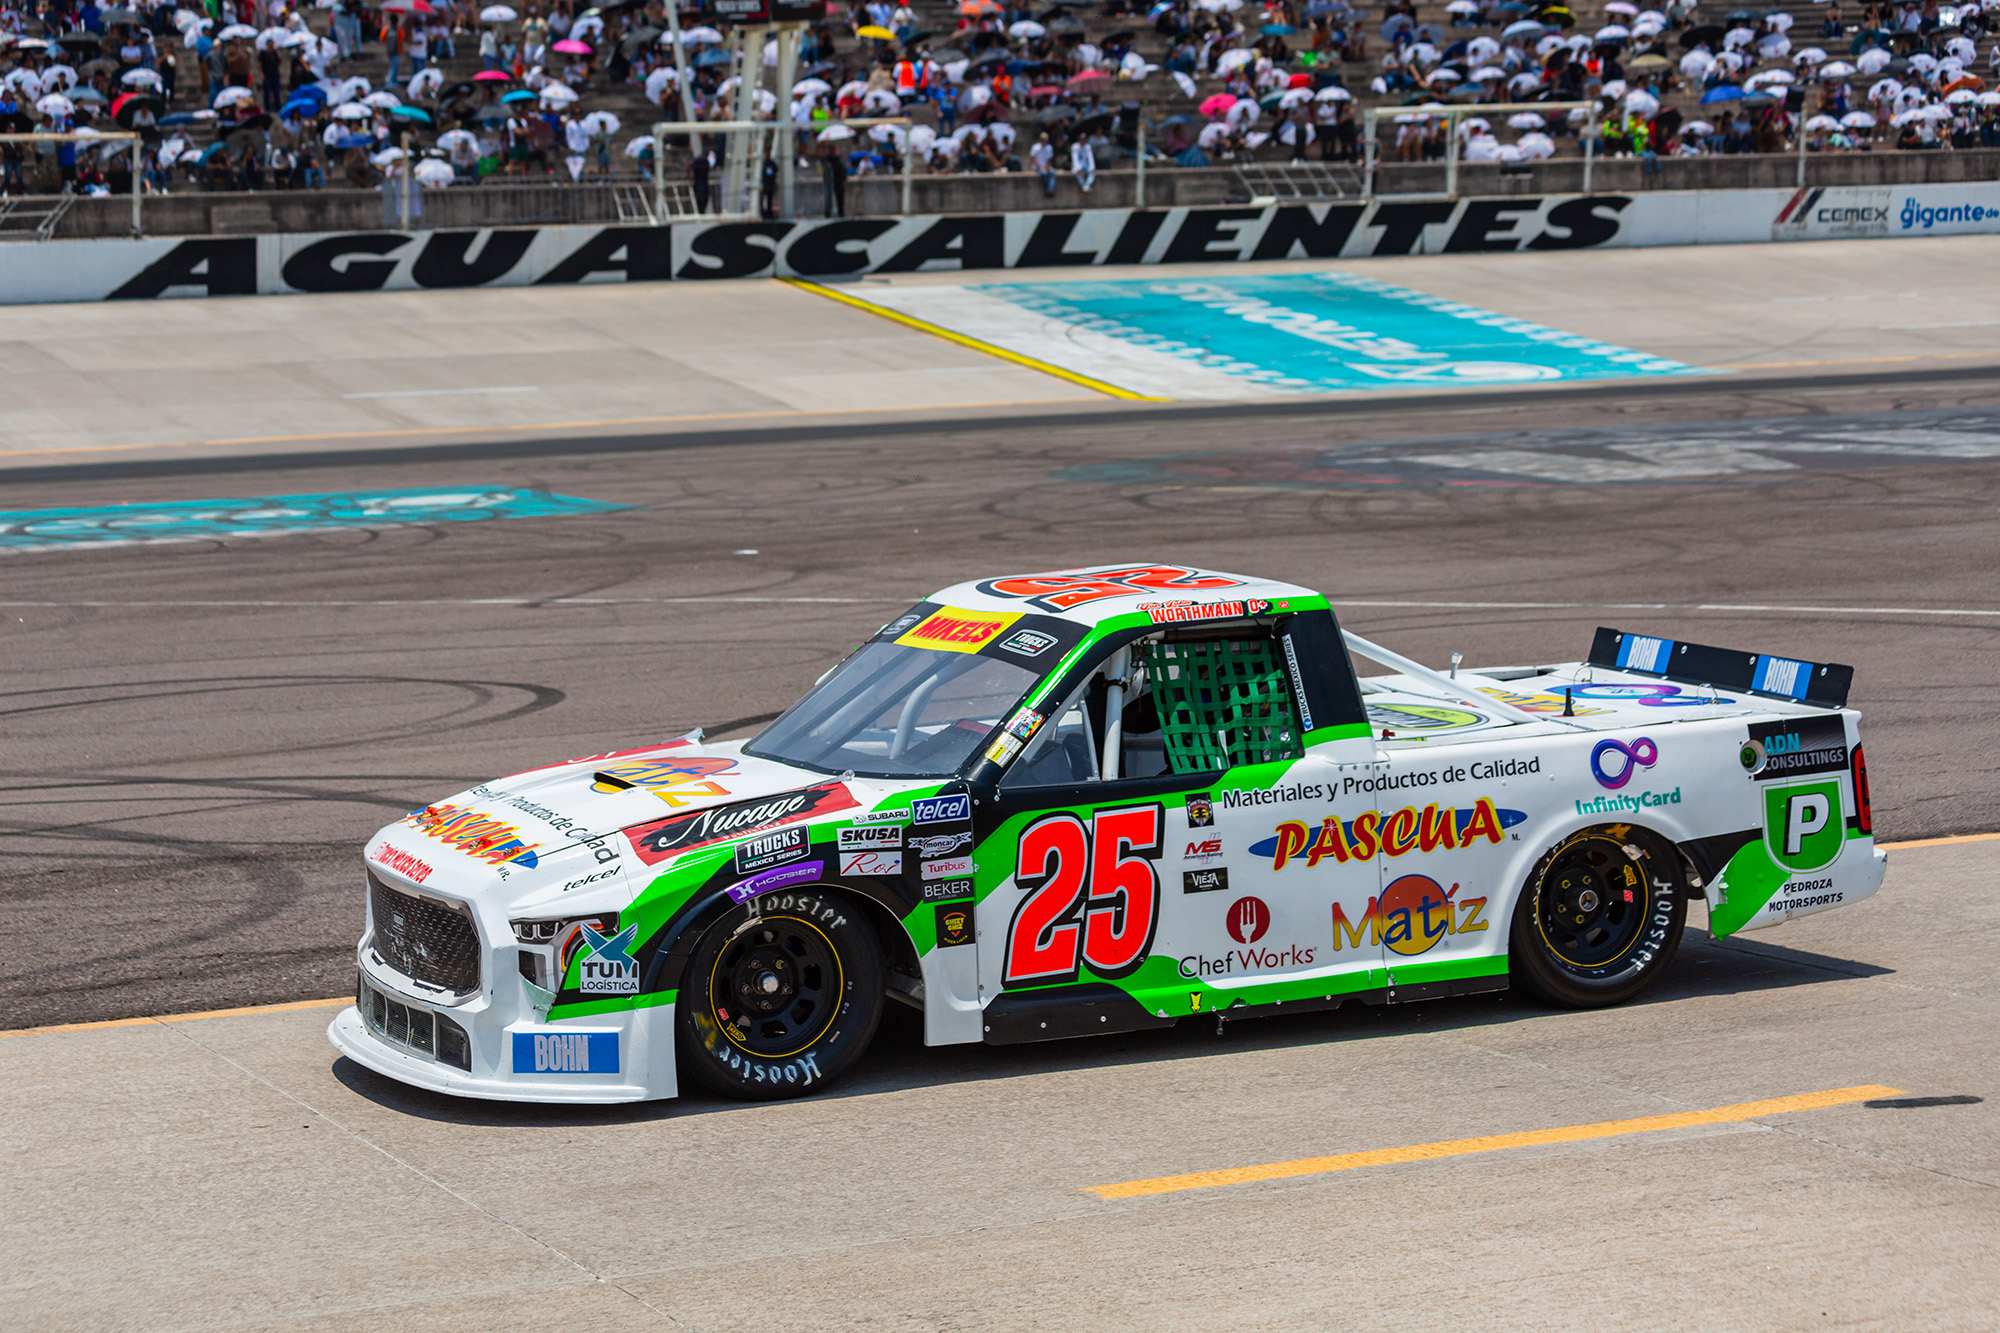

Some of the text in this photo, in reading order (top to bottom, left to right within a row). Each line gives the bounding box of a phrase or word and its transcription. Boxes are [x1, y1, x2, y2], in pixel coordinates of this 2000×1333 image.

[1817, 207, 1888, 223] CEMEX
[1900, 203, 1985, 229] gigante
[105, 195, 1632, 299] AGUASCALIENTES
[1150, 601, 1244, 624] WORTHMANN
[1015, 633, 1050, 648] TRUCKS
[1284, 637, 1294, 662] SERIES
[1626, 636, 1662, 672] BOHN
[1763, 657, 1800, 695] BOHN
[1297, 691, 1310, 718] TRUCKS
[1764, 732, 1801, 756] ADN
[1765, 749, 1845, 771] CONSULTINGS
[1223, 757, 1541, 808] Materiales y Productos de Calidad
[916, 798, 965, 820] telcel
[1575, 787, 1683, 816] InfinityCard
[658, 795, 806, 848] Nucage
[868, 810, 909, 821] SUBARU
[1783, 792, 1830, 856] P
[744, 829, 801, 858] TRUCKS
[841, 828, 900, 842] SKUSA
[926, 840, 953, 848] moncar
[1273, 797, 1507, 871] PASCUA
[745, 848, 803, 870] MÉXICO SERIES
[1185, 839, 1222, 855] MS
[562, 865, 621, 892] telcel
[755, 867, 817, 887] HOOSIER
[928, 862, 966, 873] Turibus
[1191, 872, 1220, 886] VIEJA
[924, 881, 970, 898] BEKER
[1001, 801, 1165, 991] 25
[1783, 878, 1833, 894] PEDROZA
[745, 894, 847, 929] Hoosier
[1769, 893, 1844, 912] MOTORSPORTS
[1331, 882, 1489, 951] Matíz
[1631, 877, 1673, 971] Hoosier
[582, 962, 638, 979] TUM
[1178, 946, 1315, 978] Chef Works
[582, 979, 638, 991] LOGÍSTICA
[718, 1008, 729, 1020] 25
[534, 1034, 589, 1071] BOHN
